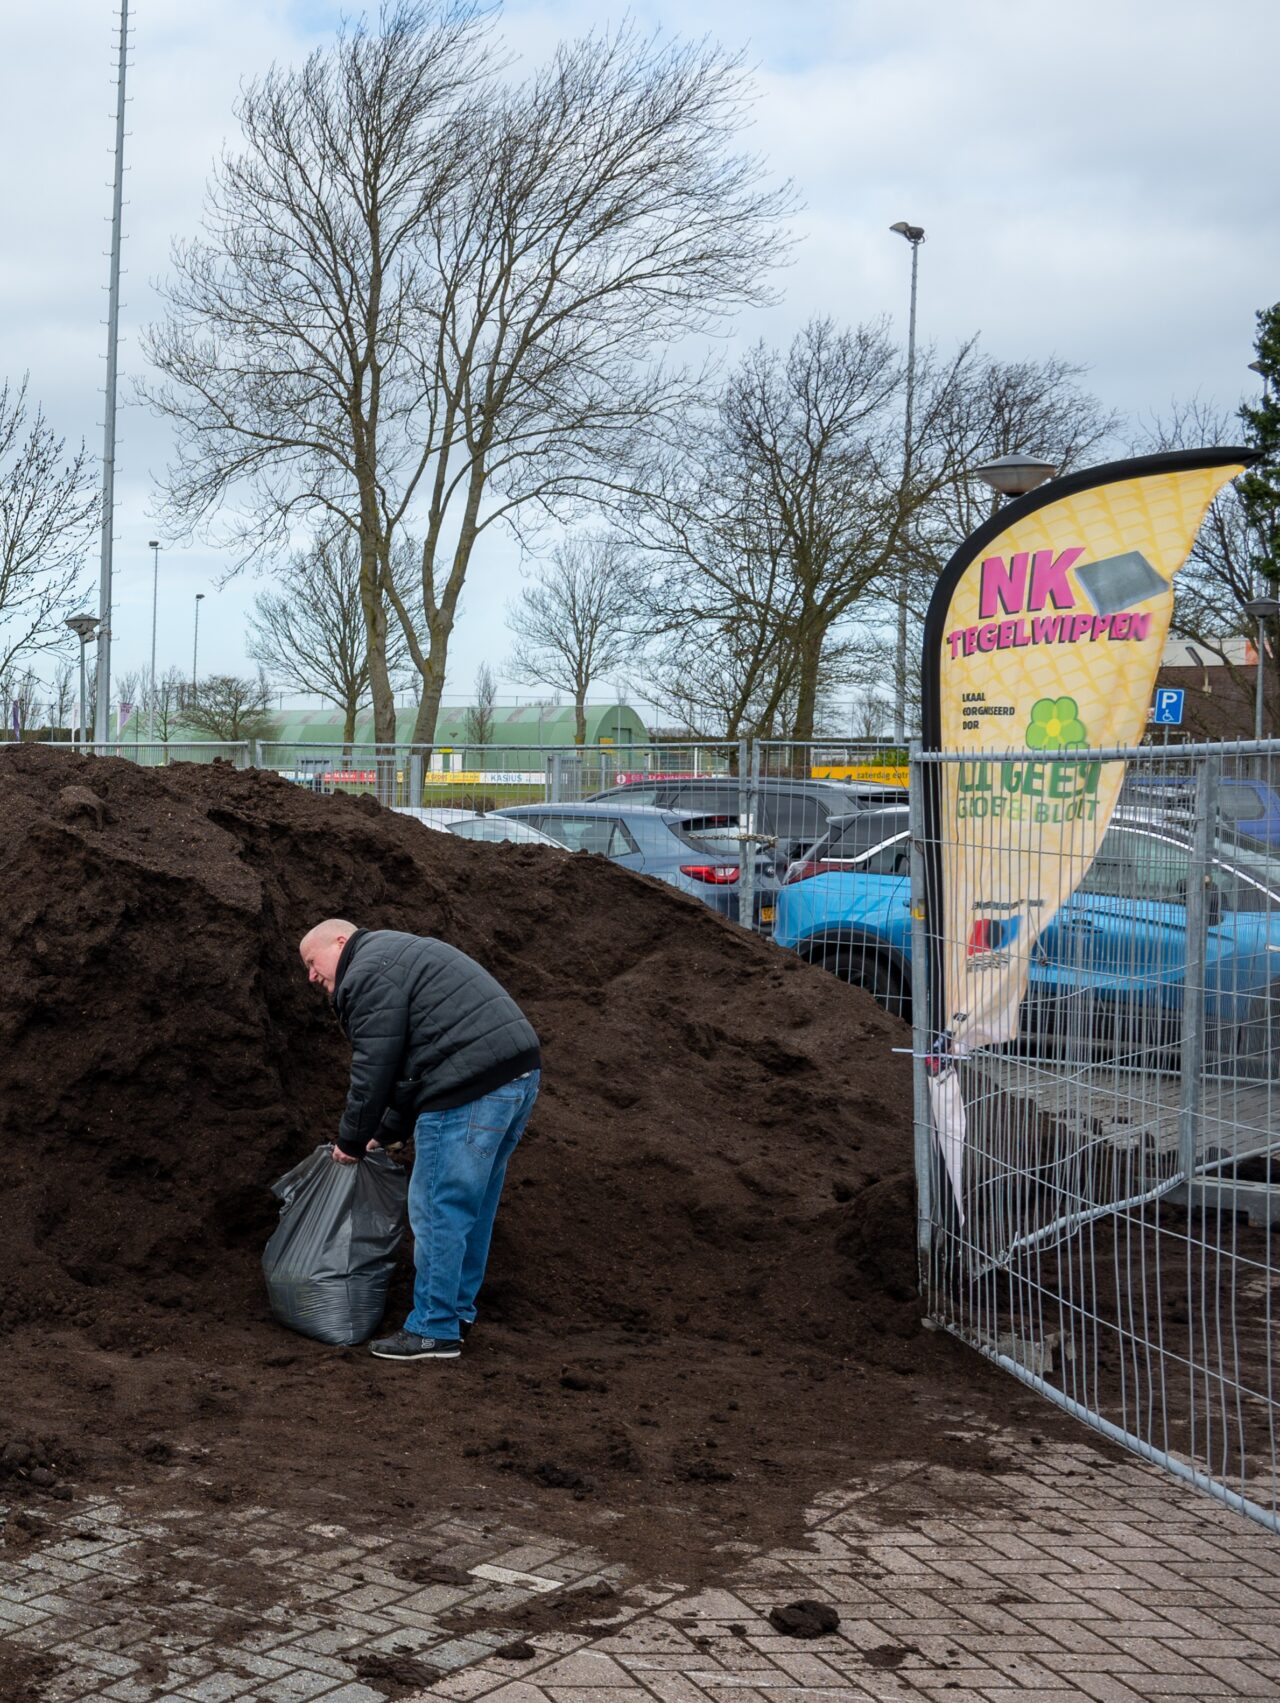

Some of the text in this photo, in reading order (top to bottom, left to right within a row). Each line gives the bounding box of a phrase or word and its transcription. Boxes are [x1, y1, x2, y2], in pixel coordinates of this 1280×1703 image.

[978, 546, 1087, 620] NK
[946, 611, 1153, 661] TEGELWIPPEN
[1161, 691, 1178, 710] P
[490, 773, 523, 783] KASIUS
[892, 771, 910, 780] entr
